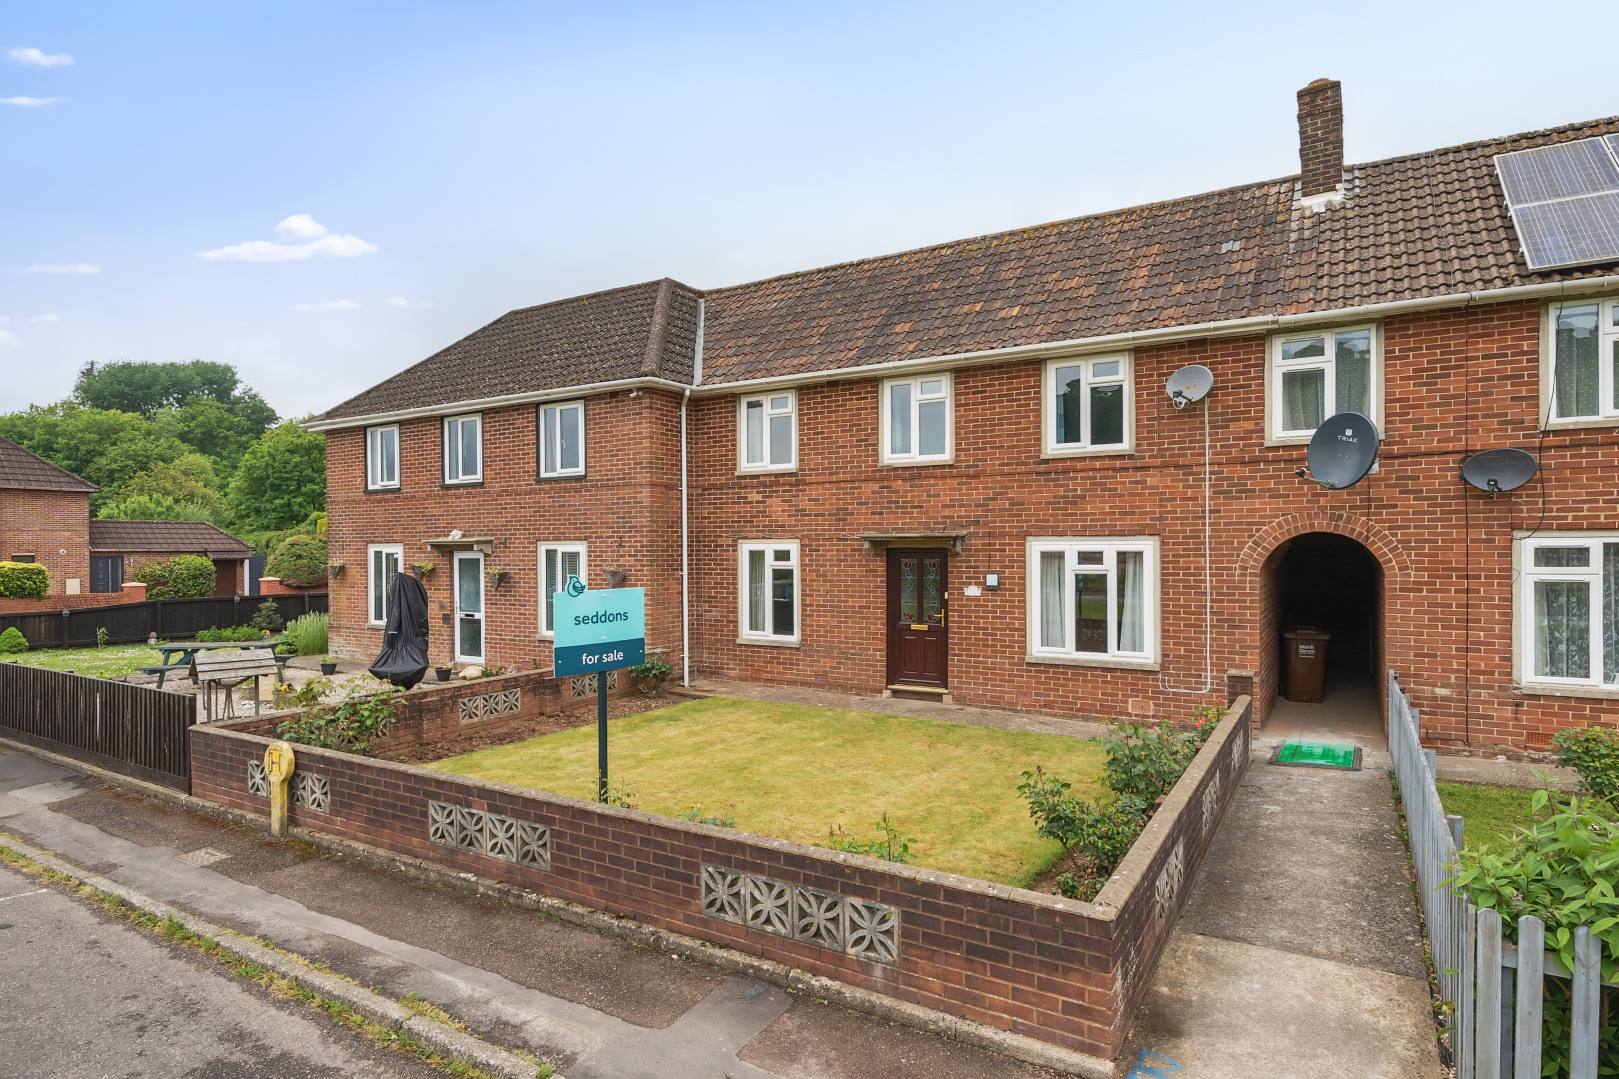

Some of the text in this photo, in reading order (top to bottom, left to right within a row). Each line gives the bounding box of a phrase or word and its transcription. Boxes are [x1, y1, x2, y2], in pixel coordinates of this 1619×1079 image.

[1337, 435, 1358, 443] TRIAX
[574, 610, 629, 626] seddons
[582, 649, 624, 665] for sale
